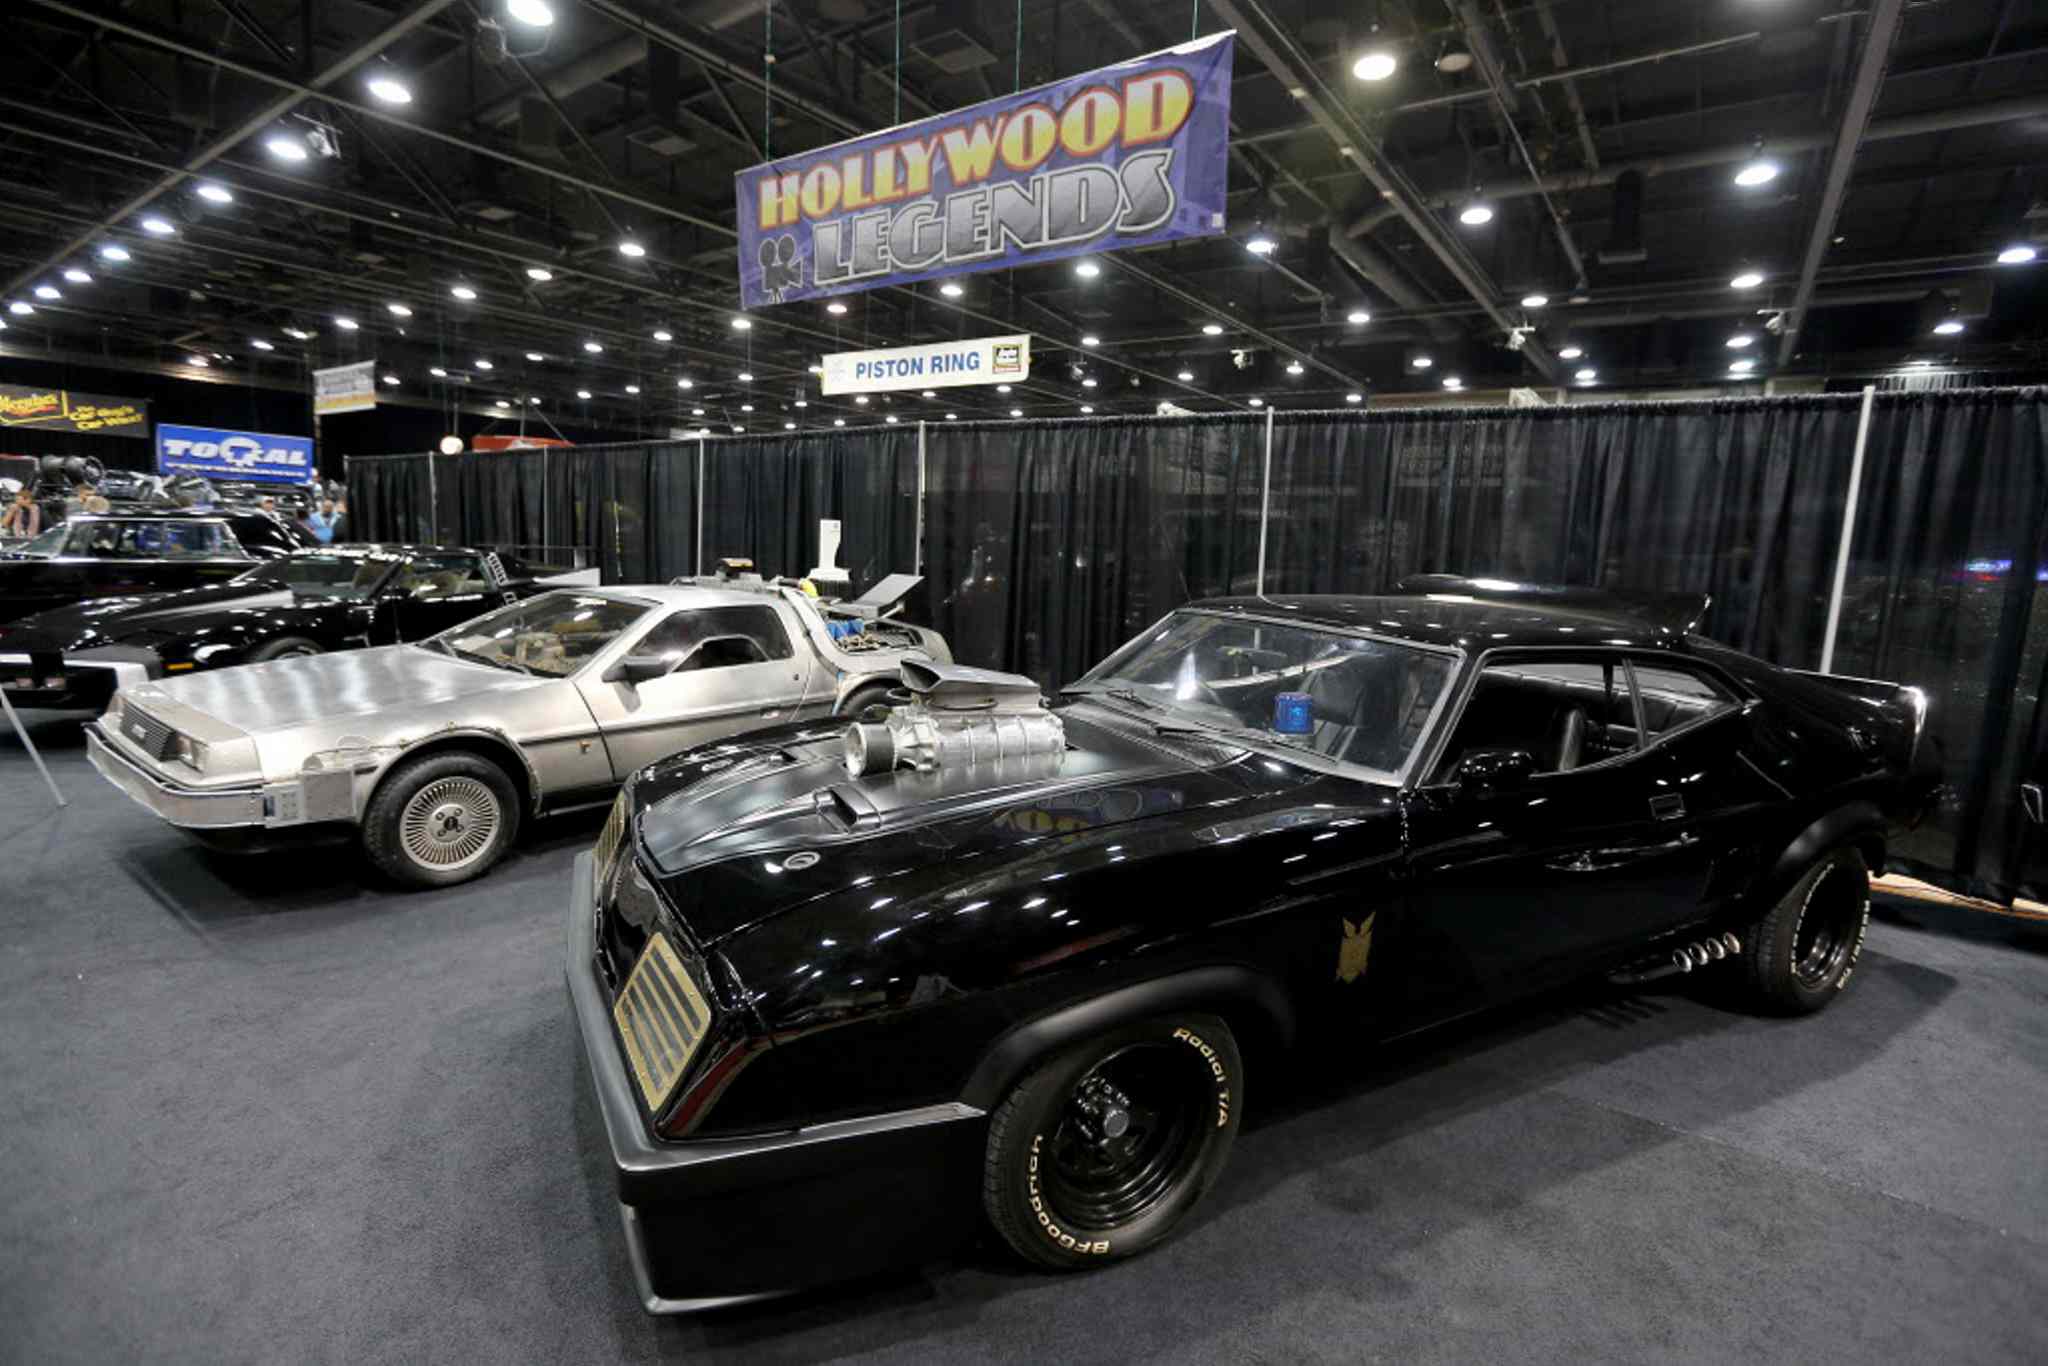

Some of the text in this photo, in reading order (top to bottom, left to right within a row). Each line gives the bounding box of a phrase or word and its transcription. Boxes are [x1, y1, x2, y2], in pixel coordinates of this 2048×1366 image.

[758, 69, 1195, 230] HOLLYWOOD
[812, 148, 1175, 285] LEGENDS
[856, 358, 924, 379] PISTON
[931, 352, 981, 373] RING
